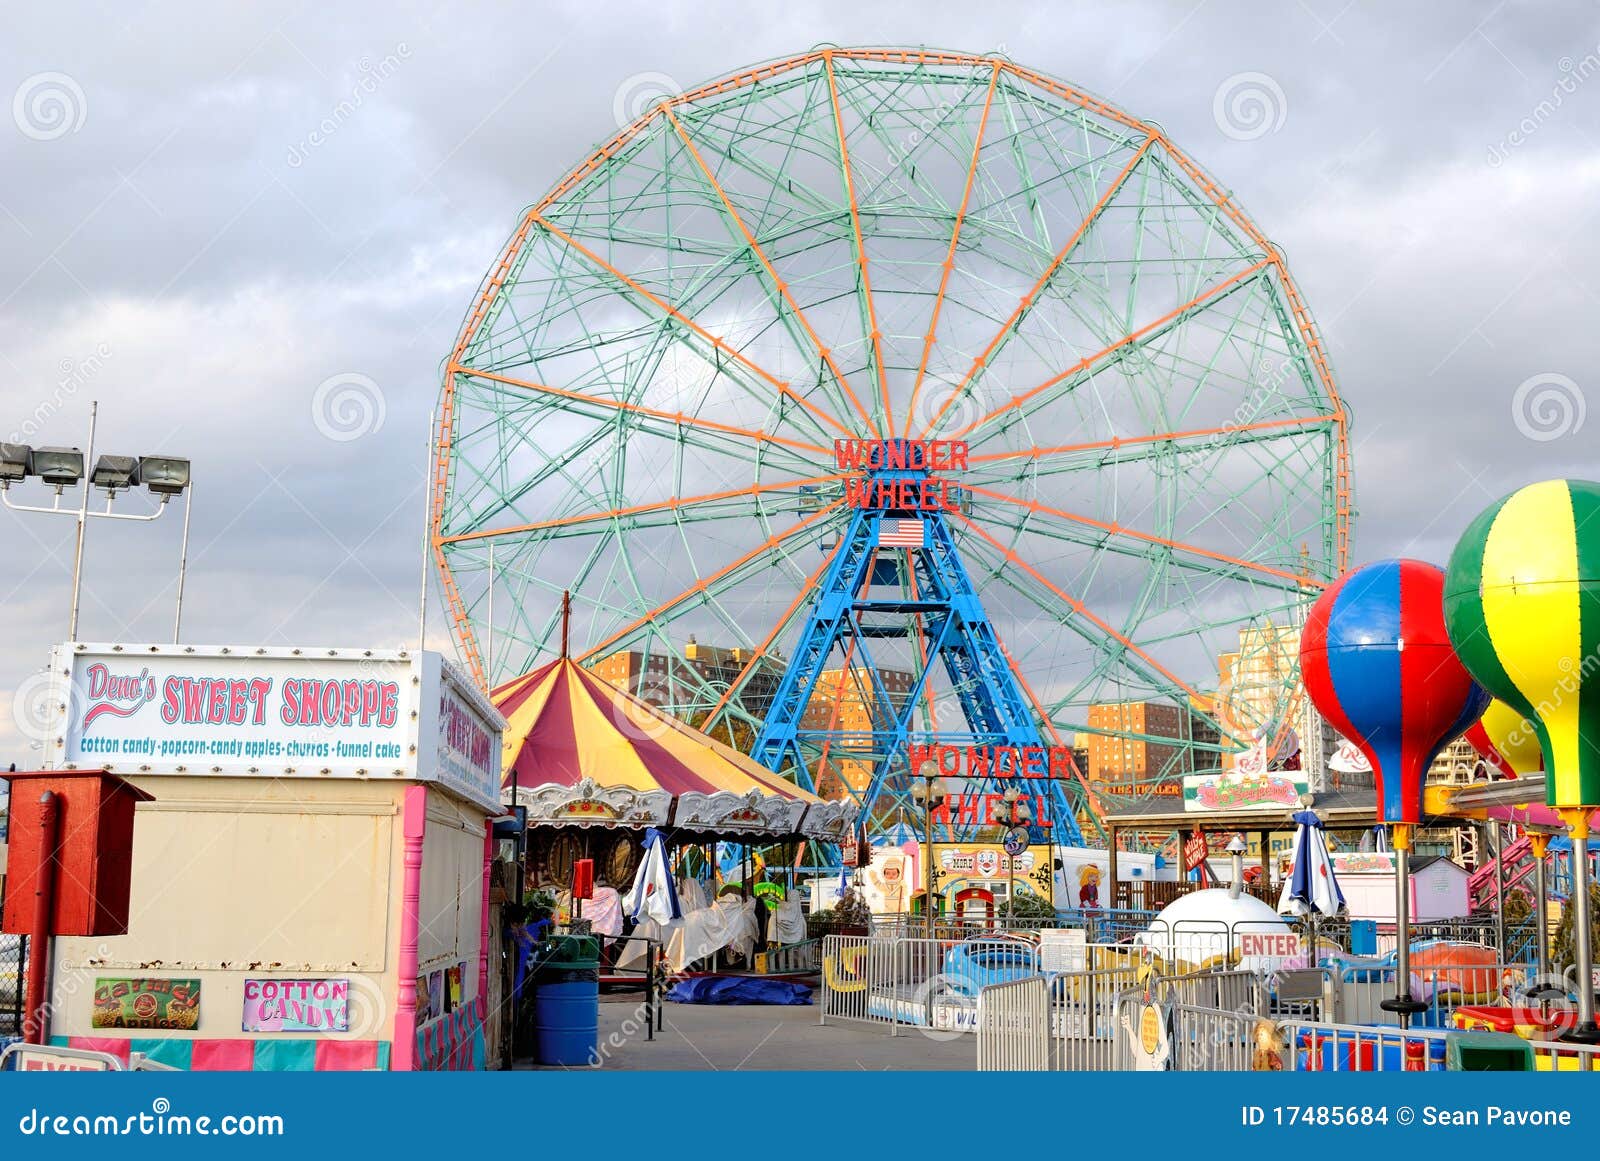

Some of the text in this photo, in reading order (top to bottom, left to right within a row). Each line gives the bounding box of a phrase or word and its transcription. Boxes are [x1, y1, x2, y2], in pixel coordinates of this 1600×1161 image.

[834, 439, 969, 470] WONDER
[843, 478, 961, 511] WHEEL
[87, 662, 157, 702] Deno's
[161, 675, 273, 726] SWEET
[280, 678, 400, 729] SHOPPE
[81, 736, 119, 753] cotton
[375, 741, 401, 759] cake
[908, 744, 1072, 778] WONDER
[953, 858, 1023, 870] MORE RIES
[1242, 935, 1298, 956] ENTER
[244, 981, 348, 1000] COTTON
[114, 1015, 178, 1030] Apples
